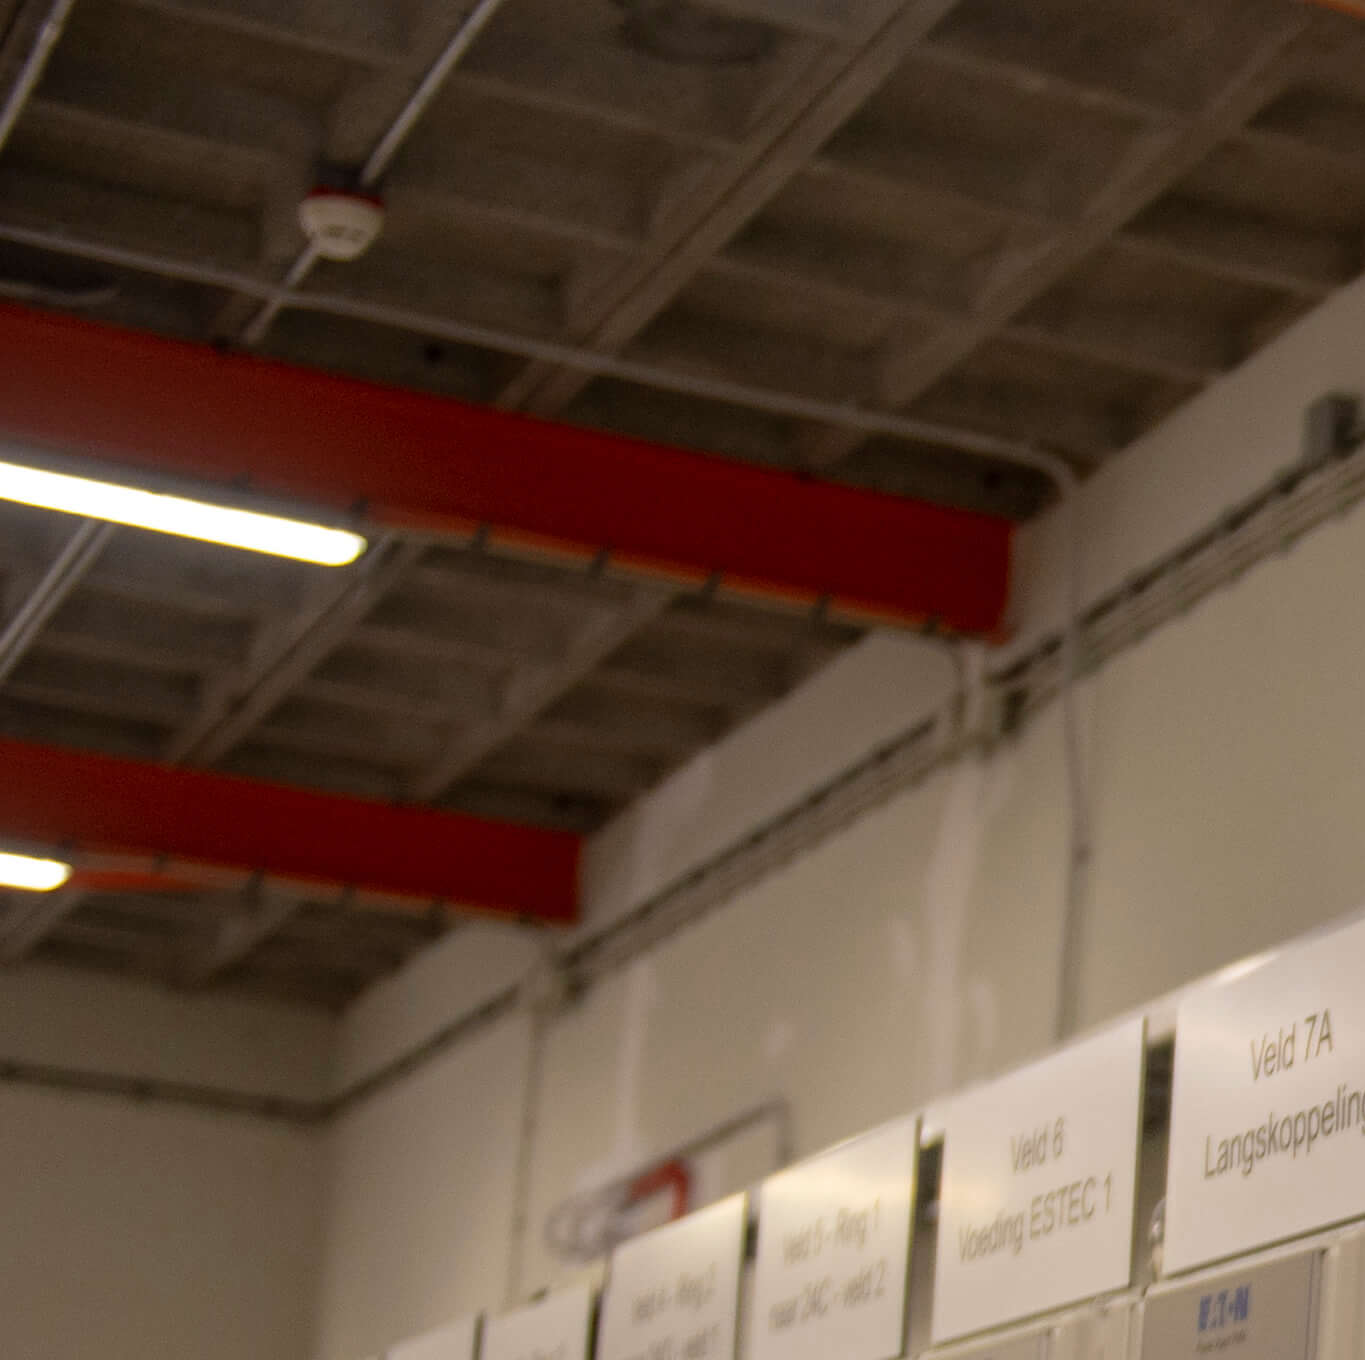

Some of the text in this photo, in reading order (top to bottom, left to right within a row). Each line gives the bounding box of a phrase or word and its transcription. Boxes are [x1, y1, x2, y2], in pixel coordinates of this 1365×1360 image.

[1249, 1008, 1334, 1081] Veld 7A
[1010, 1125, 1049, 1175] Veld
[959, 1209, 1024, 1263] Voeding
[1030, 1176, 1098, 1241] ESTEC
